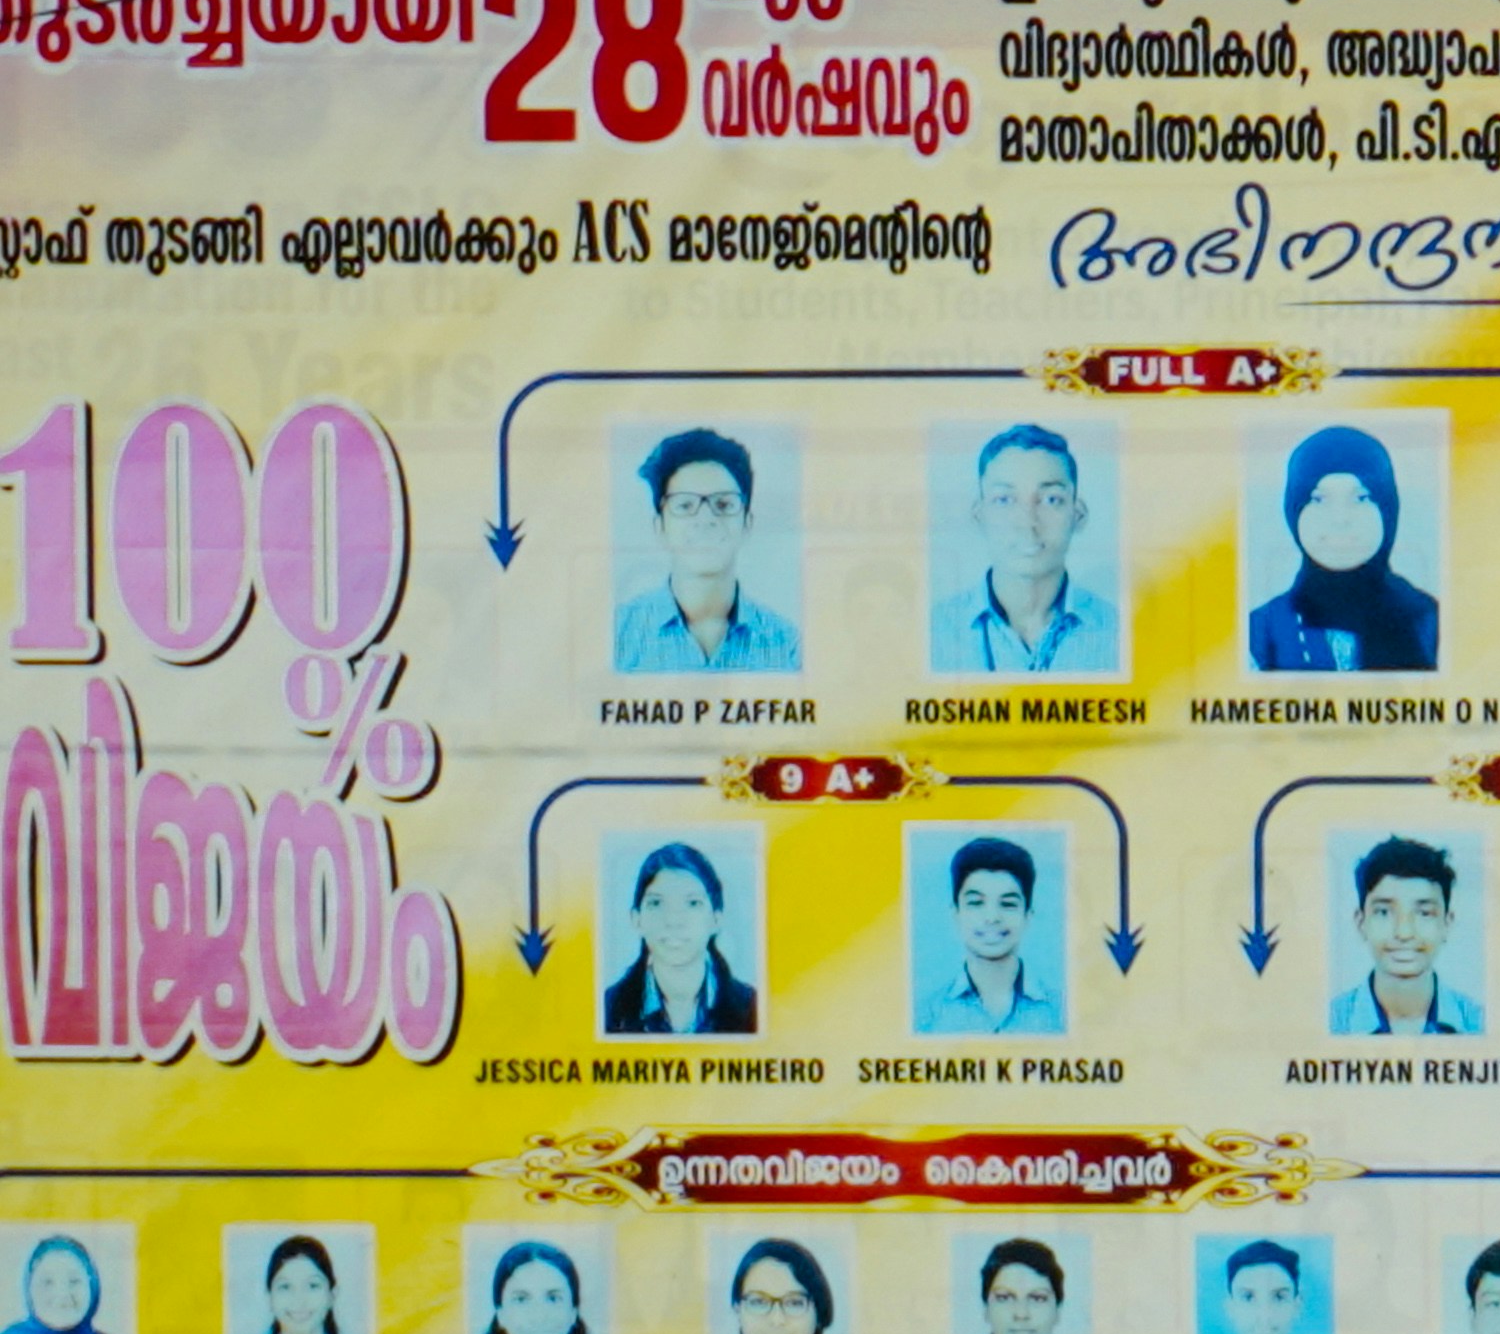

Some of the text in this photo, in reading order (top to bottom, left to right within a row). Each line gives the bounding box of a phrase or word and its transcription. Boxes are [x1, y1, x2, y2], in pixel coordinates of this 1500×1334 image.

[702, 41, 972, 157] വർഷവും
[572, 197, 652, 265] ACS
[1106, 355, 1278, 388] FULL A+
[600, 699, 816, 725] FAHAD P ZAFFAR
[905, 698, 1146, 725] ROSHAN MANEESH
[1190, 698, 1499, 725] HAMEEDHA NUSRIN O N
[780, 762, 873, 794] 9 A+
[474, 1058, 825, 1085] JESSICA MARIYA PINHEIRO
[858, 1058, 1125, 1084] SREEHARI K PRASAD
[1285, 1059, 1413, 1085] ADITHYAN
